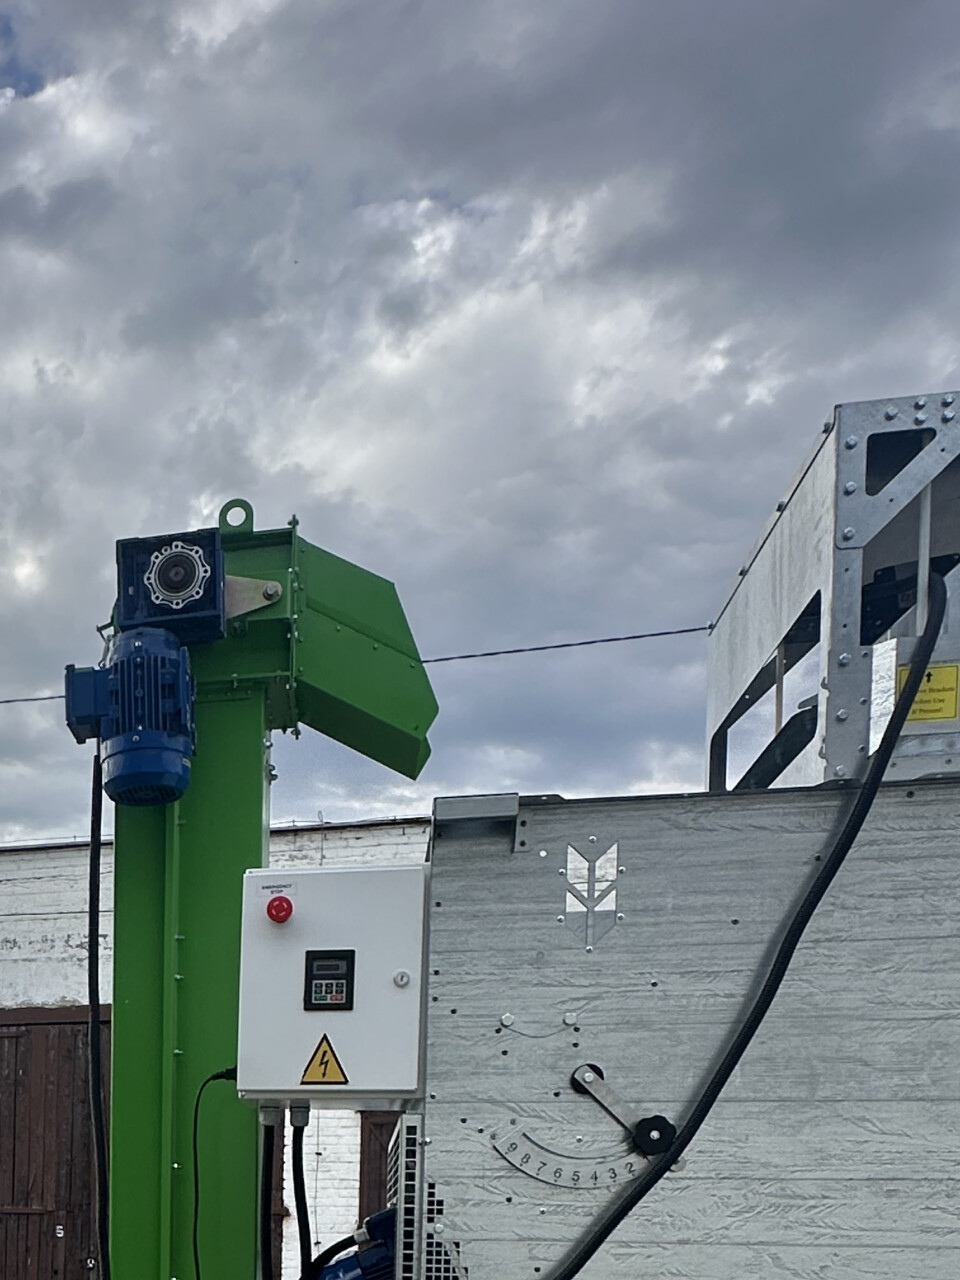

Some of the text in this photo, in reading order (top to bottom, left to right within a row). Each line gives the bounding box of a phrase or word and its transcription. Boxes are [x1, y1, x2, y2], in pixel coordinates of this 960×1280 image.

[507, 1142, 636, 1182] 9 8 7 6 5 4 3 2
[55, 1225, 64, 1237] 5
